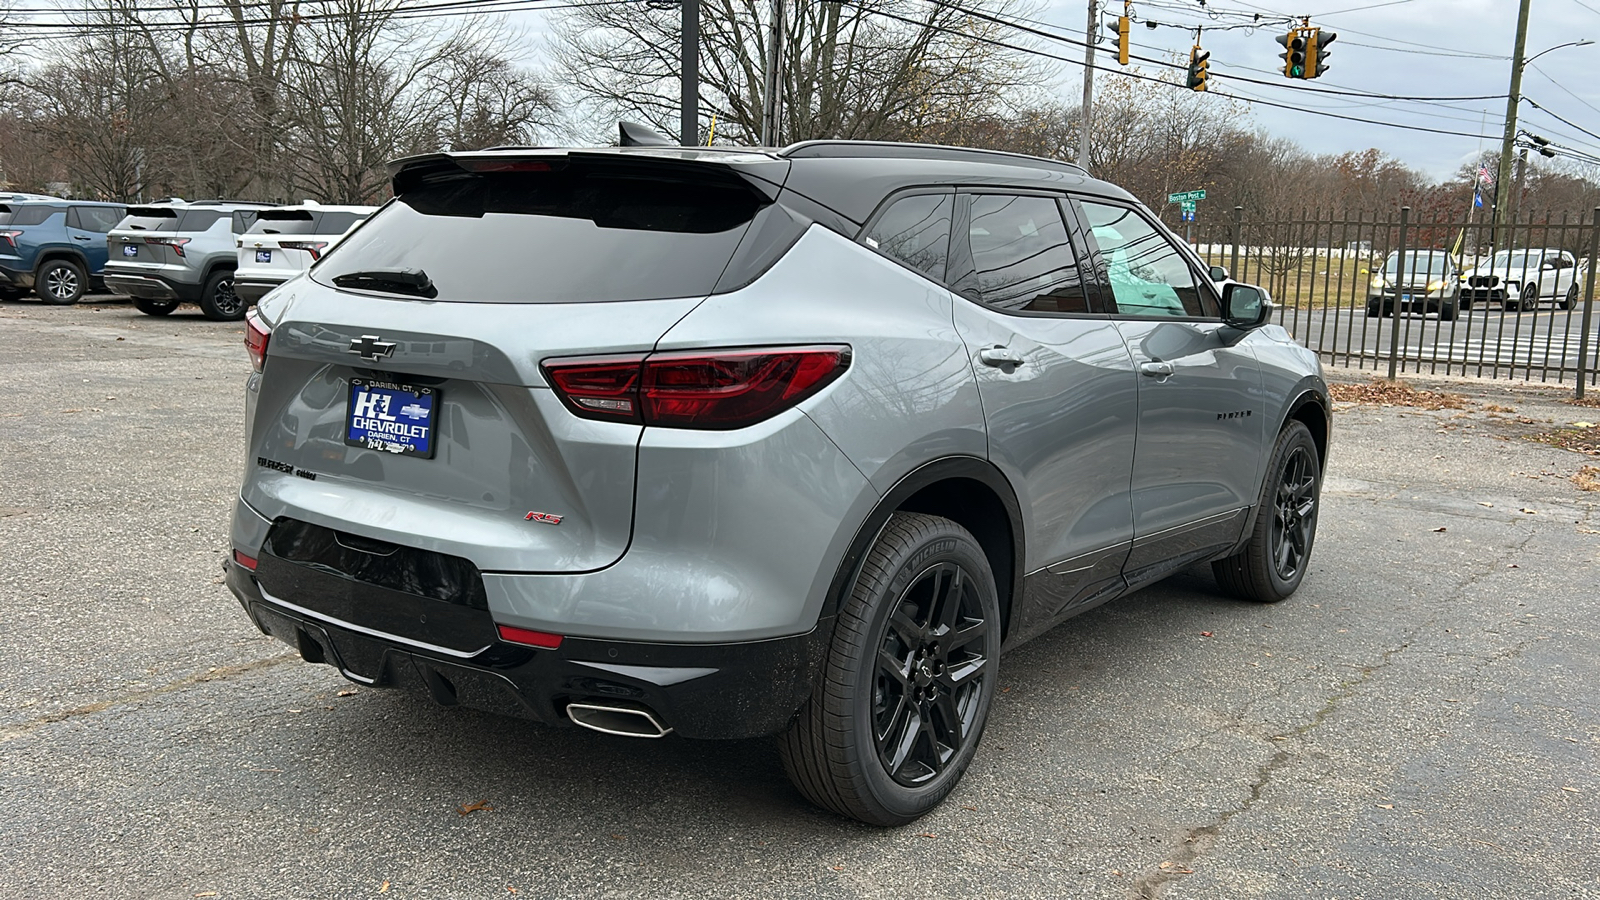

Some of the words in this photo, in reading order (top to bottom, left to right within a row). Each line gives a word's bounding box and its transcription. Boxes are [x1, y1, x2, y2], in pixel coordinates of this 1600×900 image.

[1169, 194, 1187, 202] Boston
[1188, 192, 1199, 200] Post
[353, 391, 396, 421] H&L
[353, 417, 429, 438] CHEVROLET
[523, 510, 564, 525] RS
[911, 541, 955, 570] MICHELIN
